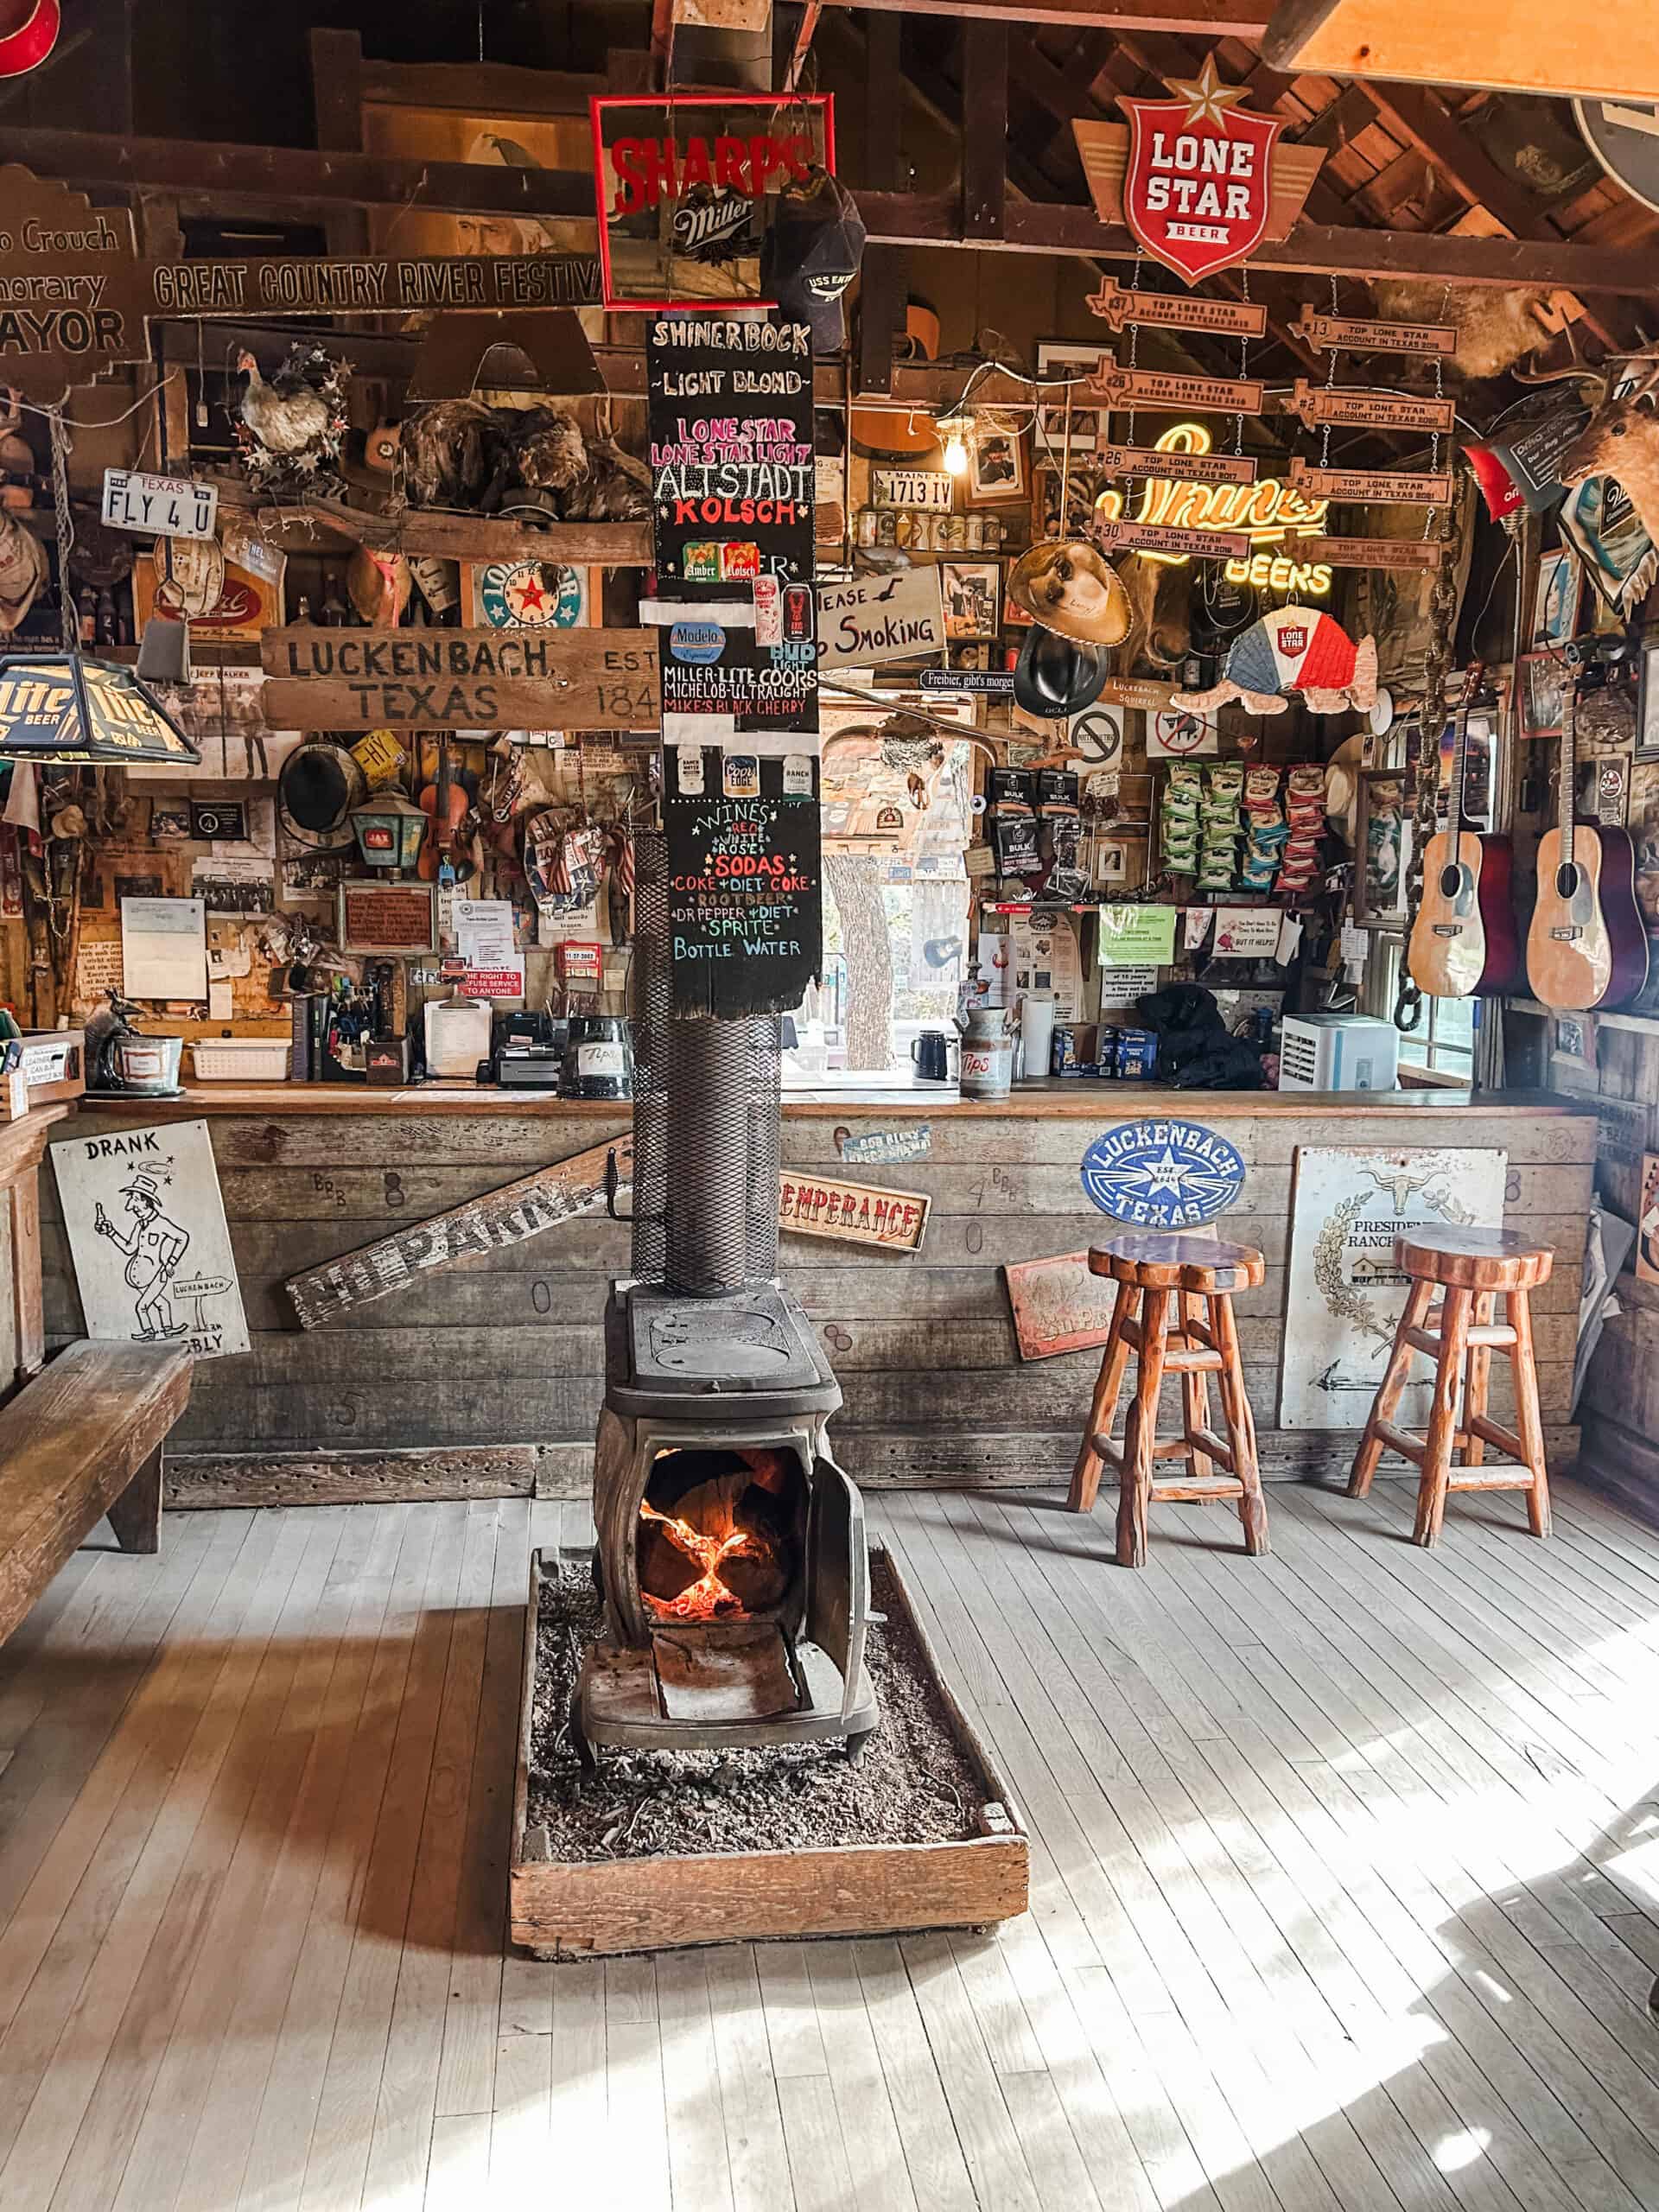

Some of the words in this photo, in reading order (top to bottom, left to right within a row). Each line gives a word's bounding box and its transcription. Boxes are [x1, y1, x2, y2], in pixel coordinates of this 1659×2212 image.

[1151, 132, 1255, 177] LONE
[1146, 176, 1252, 220] STAR
[673, 200, 755, 248] Miller
[22, 215, 118, 252] Crouch
[1176, 225, 1220, 239] BEER
[154, 264, 248, 308] GREAT
[259, 263, 388, 304] COUNTRY
[399, 262, 486, 304] RIVER
[808, 275, 830, 288] USS
[1303, 321, 1327, 335] #13
[1348, 326, 1367, 334] TOP
[1373, 328, 1397, 338] LONE
[1402, 331, 1428, 340] STAR
[652, 321, 743, 351] SHINER
[744, 322, 812, 356] BOCK
[1337, 334, 1376, 345] ACCOUNT
[1391, 338, 1419, 348] TEXAS
[663, 370, 727, 397] LIGHT
[733, 370, 803, 394] BLOND
[1299, 397, 1315, 411] #2
[1345, 401, 1363, 410] TOP
[1370, 404, 1394, 413] LONE
[1400, 406, 1426, 416] STAR
[1333, 410, 1372, 420] ACCOUNT
[1375, 412, 1386, 421] IN
[1387, 414, 1415, 423] TEXAS
[677, 416, 739, 444] LONE
[738, 417, 797, 445] STAR
[651, 442, 699, 467] LONE
[701, 442, 753, 464] STAR
[756, 443, 812, 465] LIGHT
[1096, 451, 1122, 466] #26
[1142, 455, 1162, 465] TOP
[1168, 458, 1193, 468] LONE
[1199, 461, 1227, 471] STAR
[895, 472, 931, 480] MAINE
[1131, 464, 1172, 475] ACCOUNT
[1174, 467, 1186, 475] IN
[1187, 468, 1217, 479] TEXAS
[139, 477, 185, 495] TEXAS
[653, 462, 814, 503] ALTSTADT
[1296, 475, 1314, 490] #3
[1341, 479, 1361, 487] TOP
[1367, 480, 1391, 490] LONE
[1397, 482, 1423, 491] STAR
[889, 480, 927, 504] 1713
[932, 482, 951, 505] IV
[1330, 487, 1370, 497] ACCOUNT
[1384, 490, 1414, 499] TEXAS
[108, 490, 154, 524] FLY
[168, 500, 181, 528] 4
[195, 503, 209, 532] U
[673, 497, 797, 526] KOLSCH
[1094, 524, 1120, 538] #30
[1140, 529, 1160, 537] TOP
[1165, 531, 1191, 541] LONE
[1196, 534, 1223, 543] STAR
[1128, 537, 1168, 548] ACCOUNT
[1171, 540, 1182, 549] IN
[1183, 542, 1211, 552] TEXAS
[1225, 554, 1332, 594] BEERS
[677, 628, 719, 643] Modelo
[1281, 631, 1304, 639] LONE
[1281, 639, 1304, 649] STAR
[288, 639, 550, 678] LUCKENBACH
[604, 650, 658, 671] EST
[770, 643, 817, 661] BUD
[773, 660, 809, 671] LIGHT
[759, 669, 818, 689] COORS
[963, 672, 984, 689] gibt's
[774, 687, 810, 699] LIGHT
[1112, 680, 1160, 695] LUCKENBACH
[348, 683, 499, 721] TEXAS
[597, 684, 659, 720] 184
[664, 699, 714, 713] MIKE'S
[715, 700, 753, 715] BLACK
[756, 699, 806, 715] CHERRY
[1119, 694, 1156, 707] SQUIRREL
[24, 714, 60, 726] BEER
[730, 777, 753, 787] EDGE
[1003, 790, 1024, 799] BULK
[696, 804, 770, 830] WINES
[732, 822, 758, 835] RED
[368, 834, 390, 844] JAX
[719, 834, 766, 845] WHITE
[1008, 842, 1031, 853] BULK
[715, 854, 786, 877] SODAS
[674, 875, 717, 891] COKE
[729, 876, 762, 892] DIET
[770, 875, 810, 891] COKE
[677, 906, 696, 922] DR
[697, 906, 747, 921] PEPPER
[759, 905, 793, 919] DIET
[709, 918, 775, 937] SPRITE
[85, 1132, 160, 1160] DRANK
[1091, 1123, 1239, 1178] LUCKENBACH
[778, 1182, 921, 1238] EMPERANCE
[1115, 1194, 1202, 1226] TEXAS
[175, 1281, 226, 1294] LUCKENBACH
